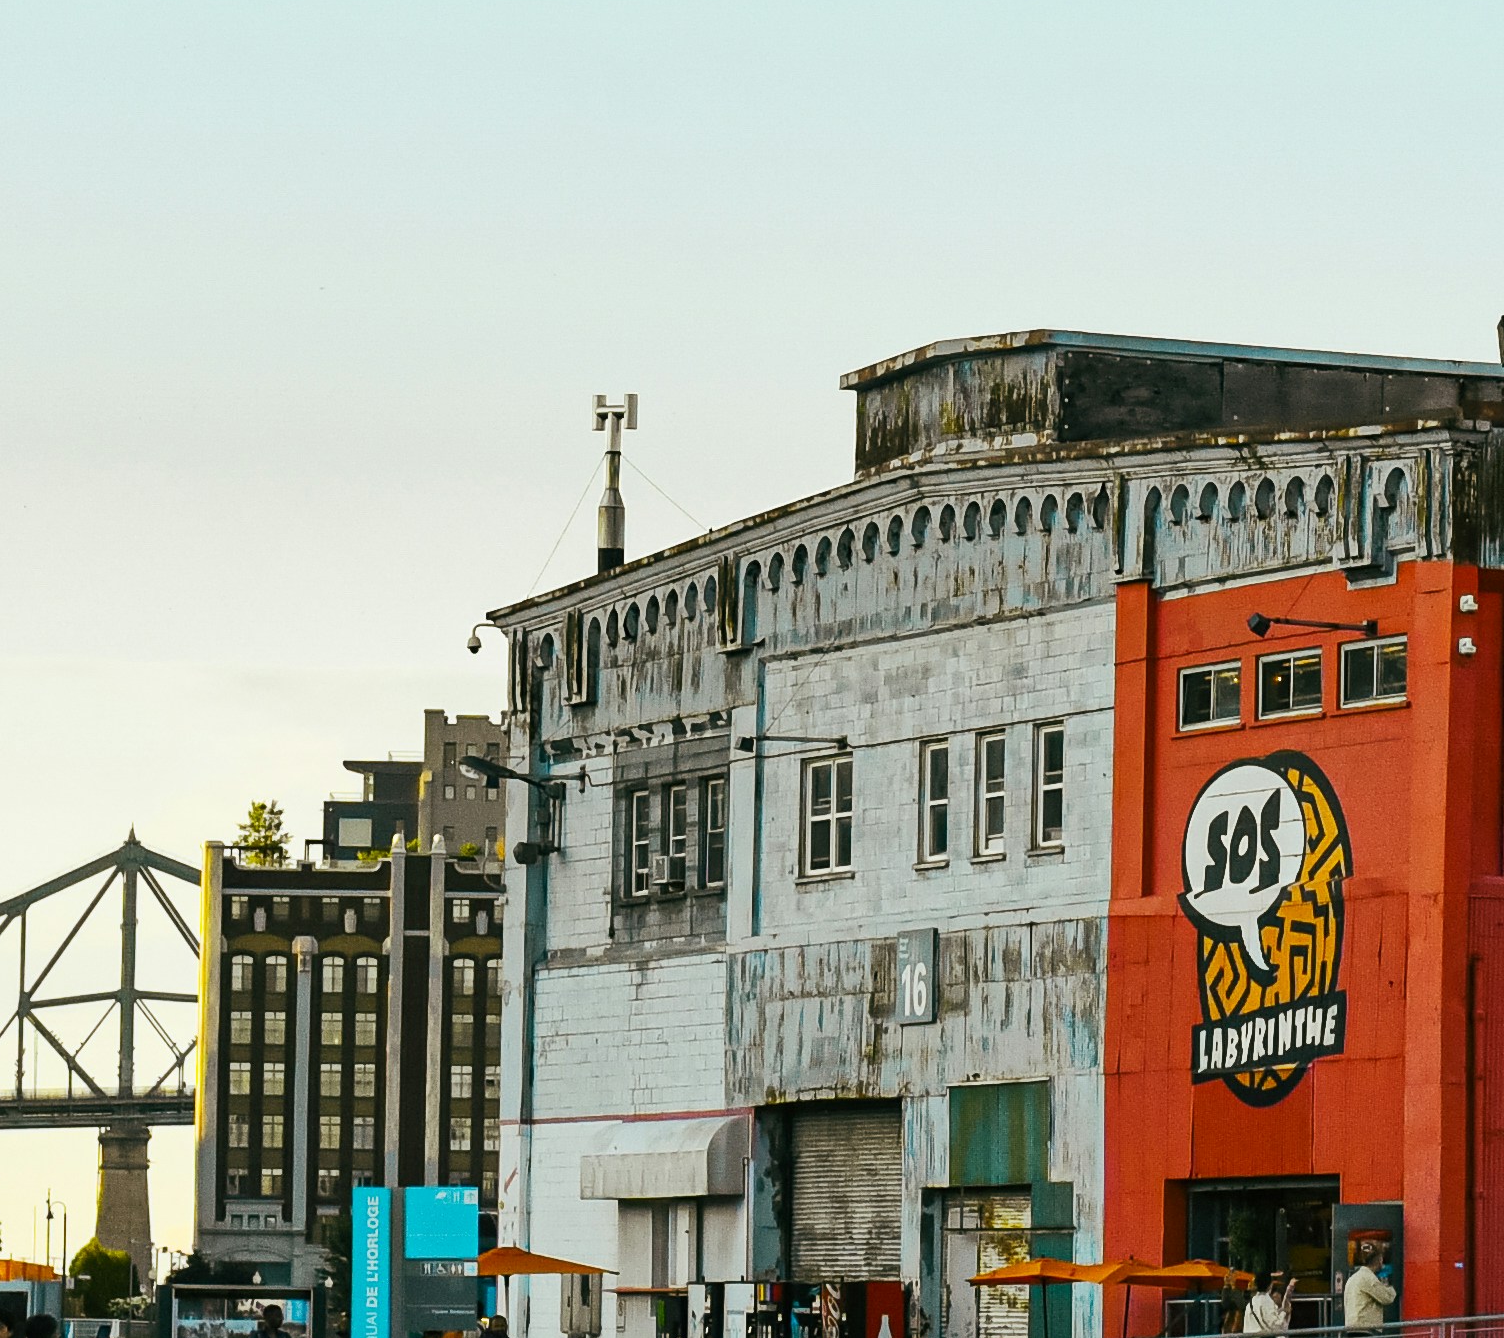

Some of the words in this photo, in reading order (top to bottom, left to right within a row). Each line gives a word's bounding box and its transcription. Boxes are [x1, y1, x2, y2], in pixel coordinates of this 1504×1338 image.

[1194, 788, 1281, 899] SOS
[901, 961, 926, 1017] 16
[1198, 1004, 1338, 1073] LABYRINTHE
[366, 1195, 380, 1282] L'HORLOGE
[366, 1286, 379, 1308] DE
